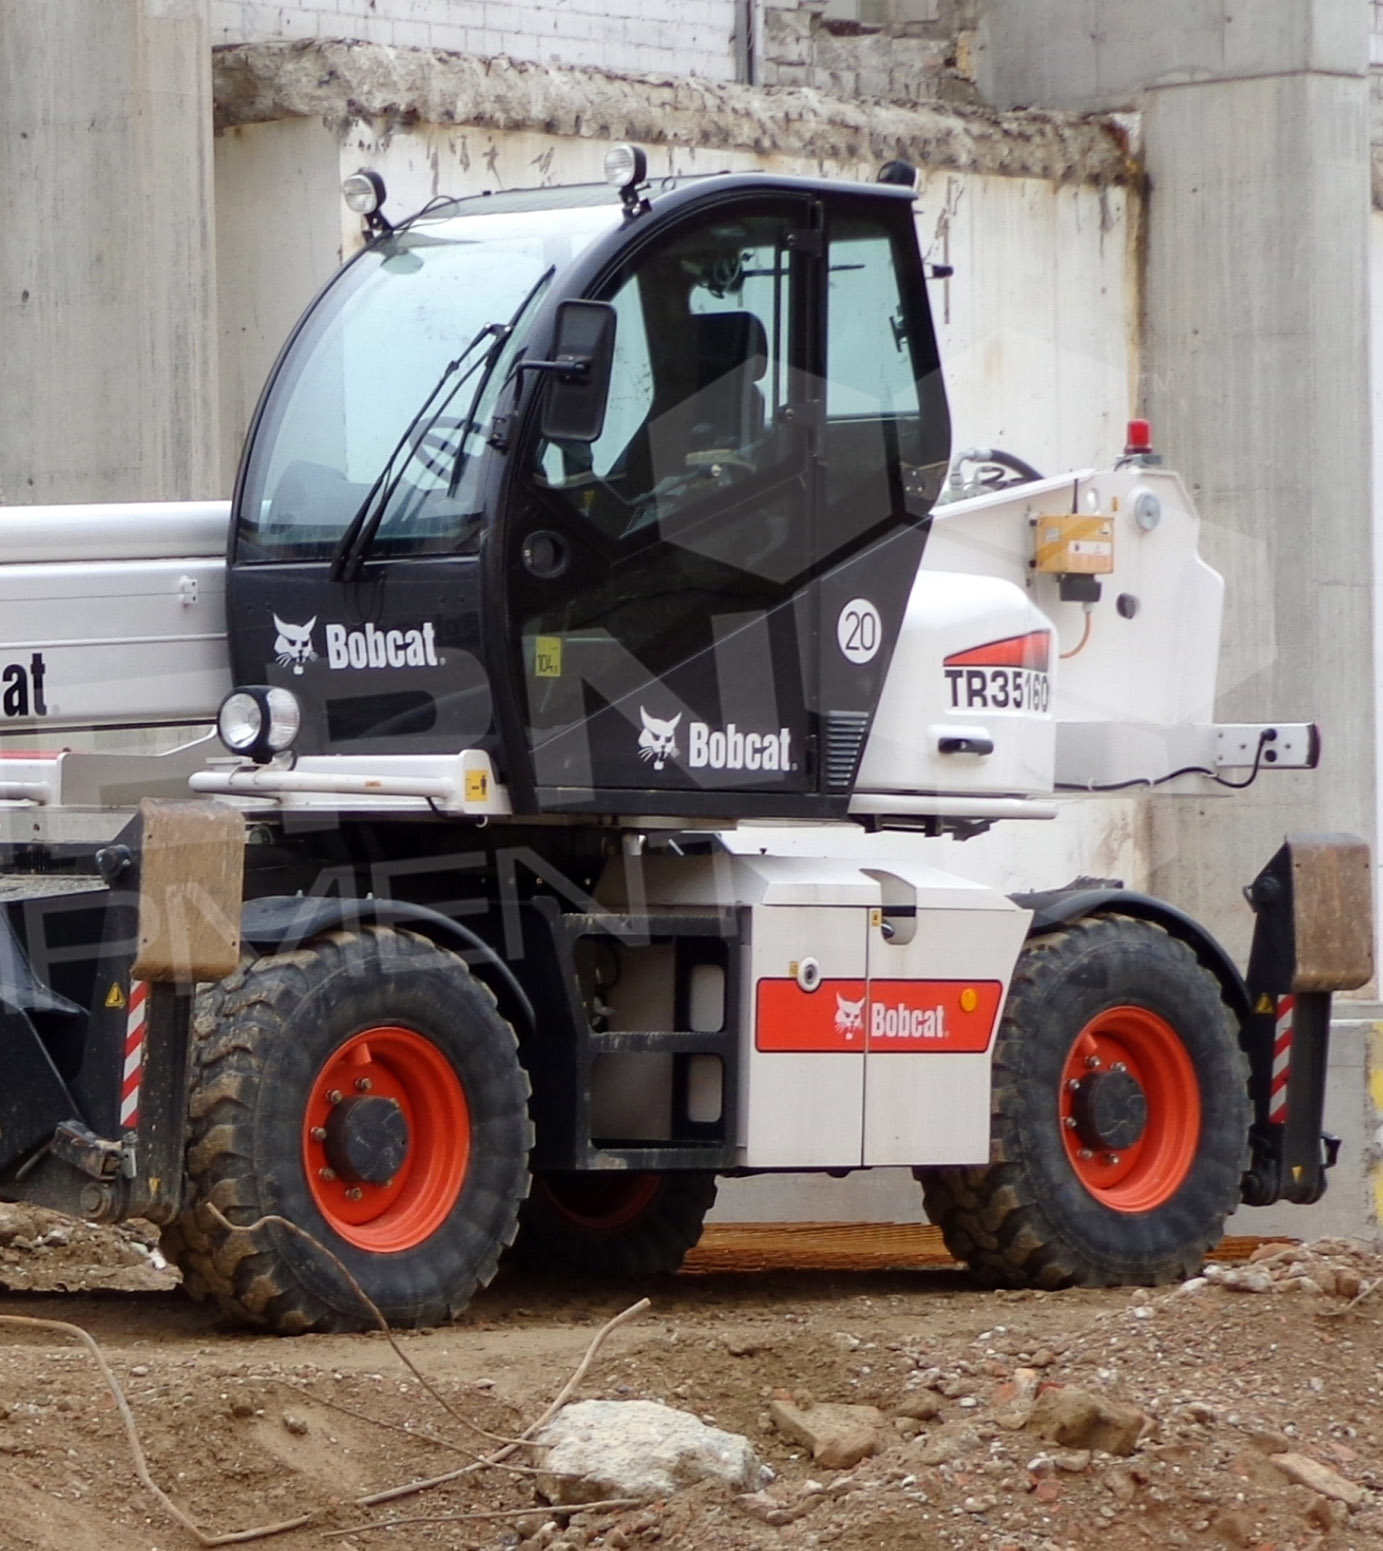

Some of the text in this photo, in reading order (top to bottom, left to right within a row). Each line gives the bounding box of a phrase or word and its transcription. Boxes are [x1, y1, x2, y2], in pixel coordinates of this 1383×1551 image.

[326, 621, 438, 669] Bobcat
[845, 611, 876, 651] 20
[944, 669, 1049, 712] TR35160
[689, 721, 790, 772] Bobcat
[872, 1002, 944, 1038] Bobcat
